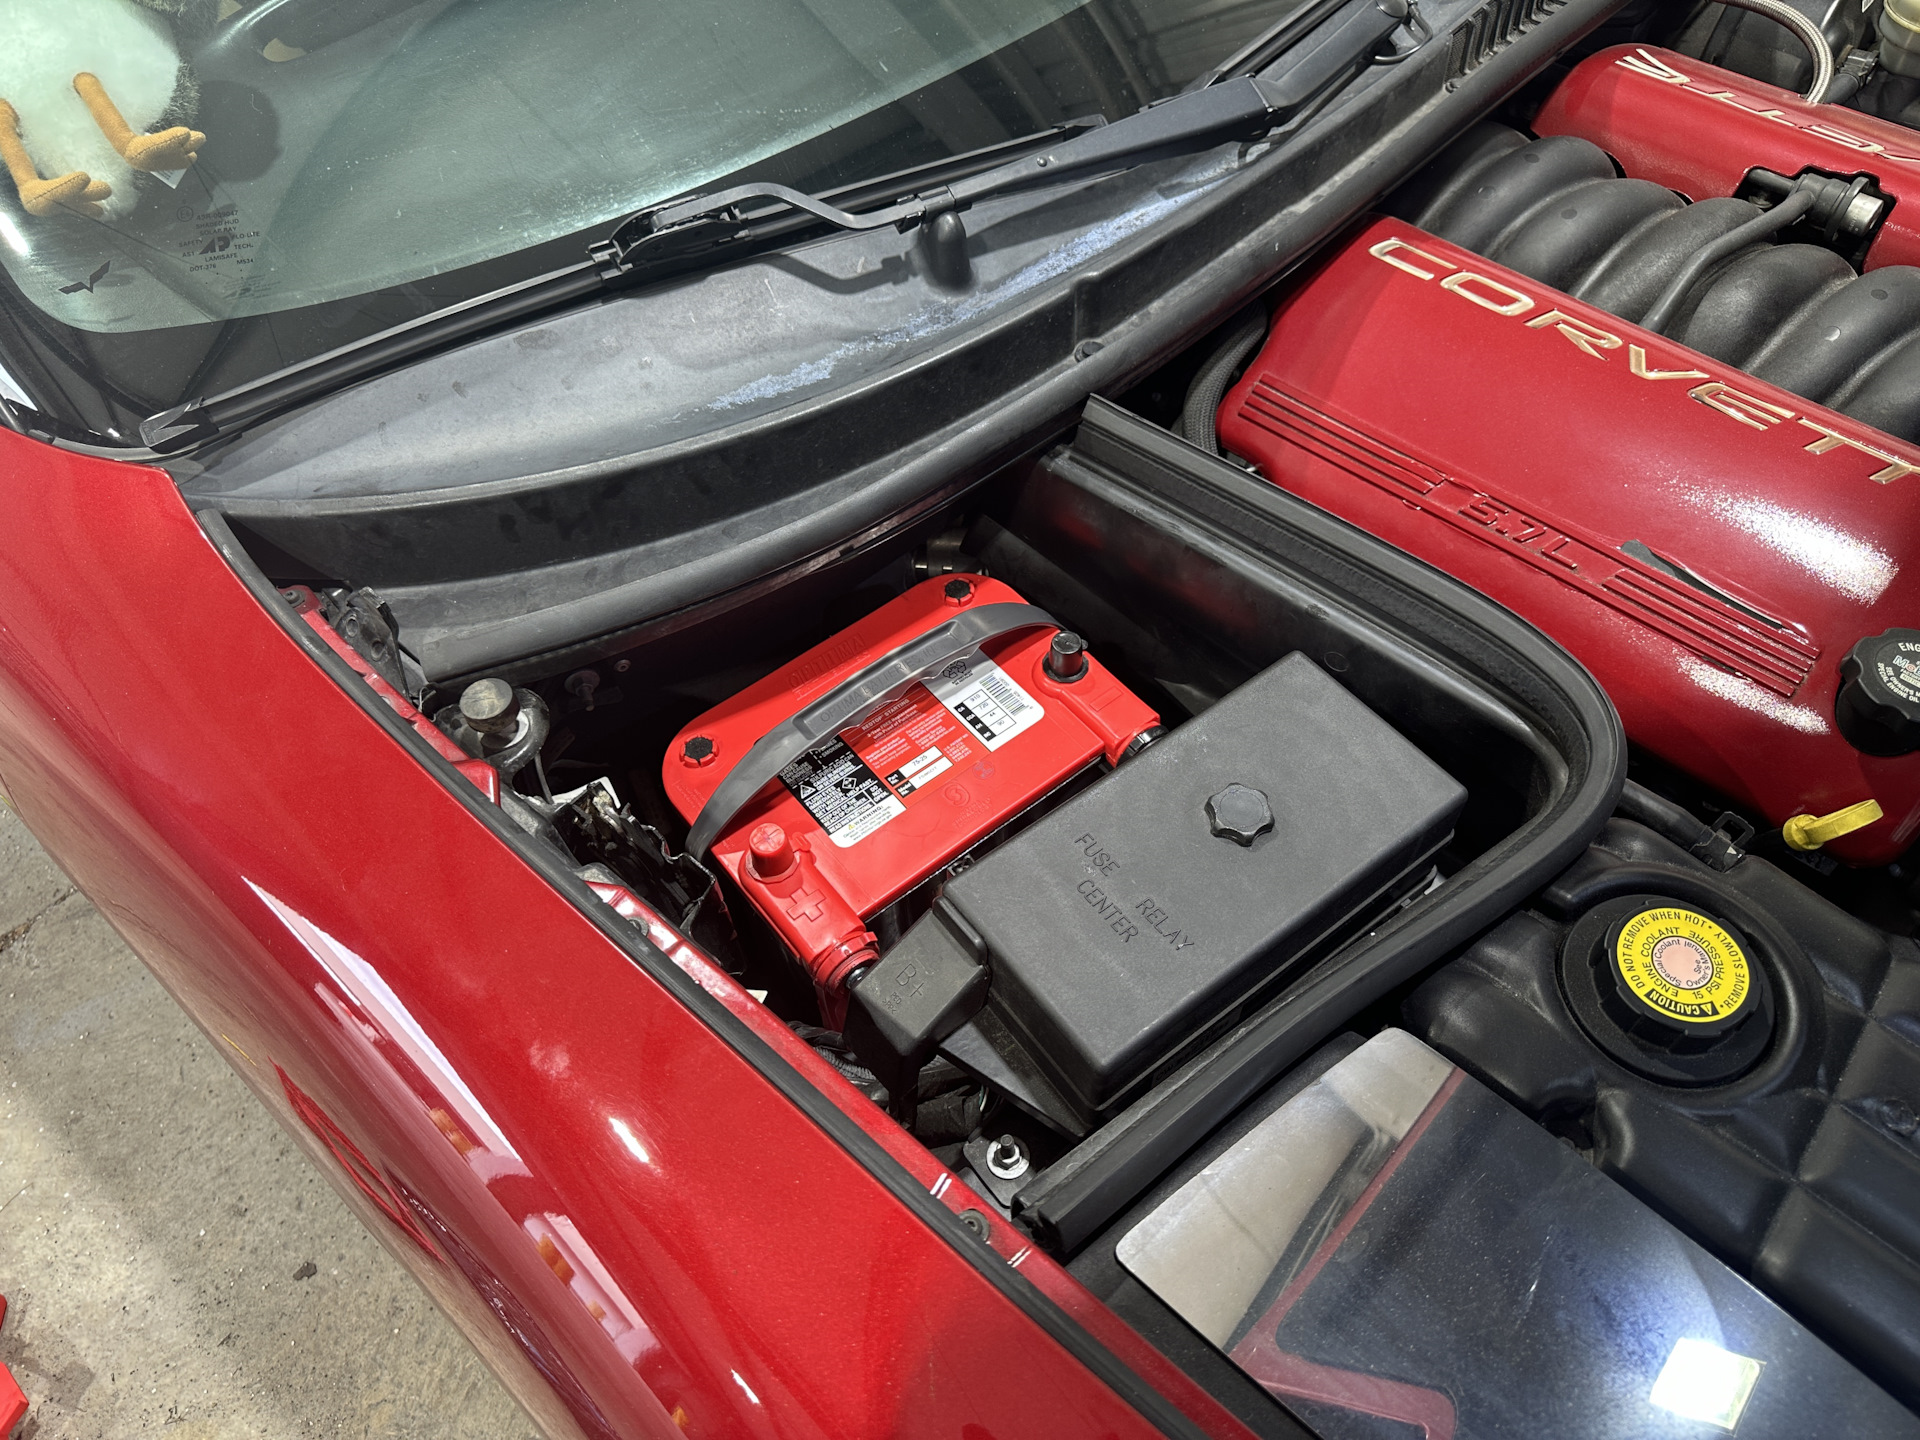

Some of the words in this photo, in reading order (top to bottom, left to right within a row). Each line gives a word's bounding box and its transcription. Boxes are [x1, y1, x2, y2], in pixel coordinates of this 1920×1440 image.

[179, 239, 203, 248] SAFETY
[205, 253, 237, 262] LAMISAFE
[1458, 497, 1578, 571] 5.7L
[1877, 661, 1890, 684] SPECIAL
[1886, 682, 1909, 699] ENGINE
[1908, 695, 1920, 704] OIL
[1885, 666, 1895, 677] SEE
[816, 689, 864, 723] OPTIMA
[883, 698, 910, 717] STARTING
[820, 741, 844, 758] SMOKING
[912, 754, 928, 766] 75-25
[785, 764, 813, 784] BLINDNESS
[809, 766, 835, 784] SULFURIC
[832, 759, 845, 769] ACID
[843, 753, 855, 762] CAN
[808, 787, 843, 811] IMMEDIATELY
[814, 808, 827, 818] GET
[824, 795, 848, 811] MEDICAL
[846, 786, 861, 798] HELP
[853, 805, 884, 826] WARNING:
[1074, 833, 1121, 877] FUSE
[1135, 898, 1195, 951] RELAY
[1076, 880, 1139, 943] CENTER
[1648, 910, 1682, 922] WHEN
[1684, 913, 1708, 928] HOT
[1623, 915, 1650, 951] REMOVE
[1640, 926, 1681, 958] COOLANT
[1654, 938, 1682, 959] Coolant
[1684, 940, 1710, 965] Manual
[1687, 929, 1725, 981] PRESSURE
[1713, 931, 1743, 970] SLOWLY
[1622, 951, 1635, 972] NOT
[1654, 959, 1683, 987] Special
[1693, 959, 1703, 975] See
[1630, 974, 1646, 989] DO
[1641, 961, 1680, 998] ENGINE
[1685, 964, 1712, 988] Owner's
[1705, 980, 1723, 995] PSI
[1648, 988, 1701, 1016] CAUTION
[1692, 990, 1705, 1000] 15
[1722, 972, 1746, 1010] REMOVE
